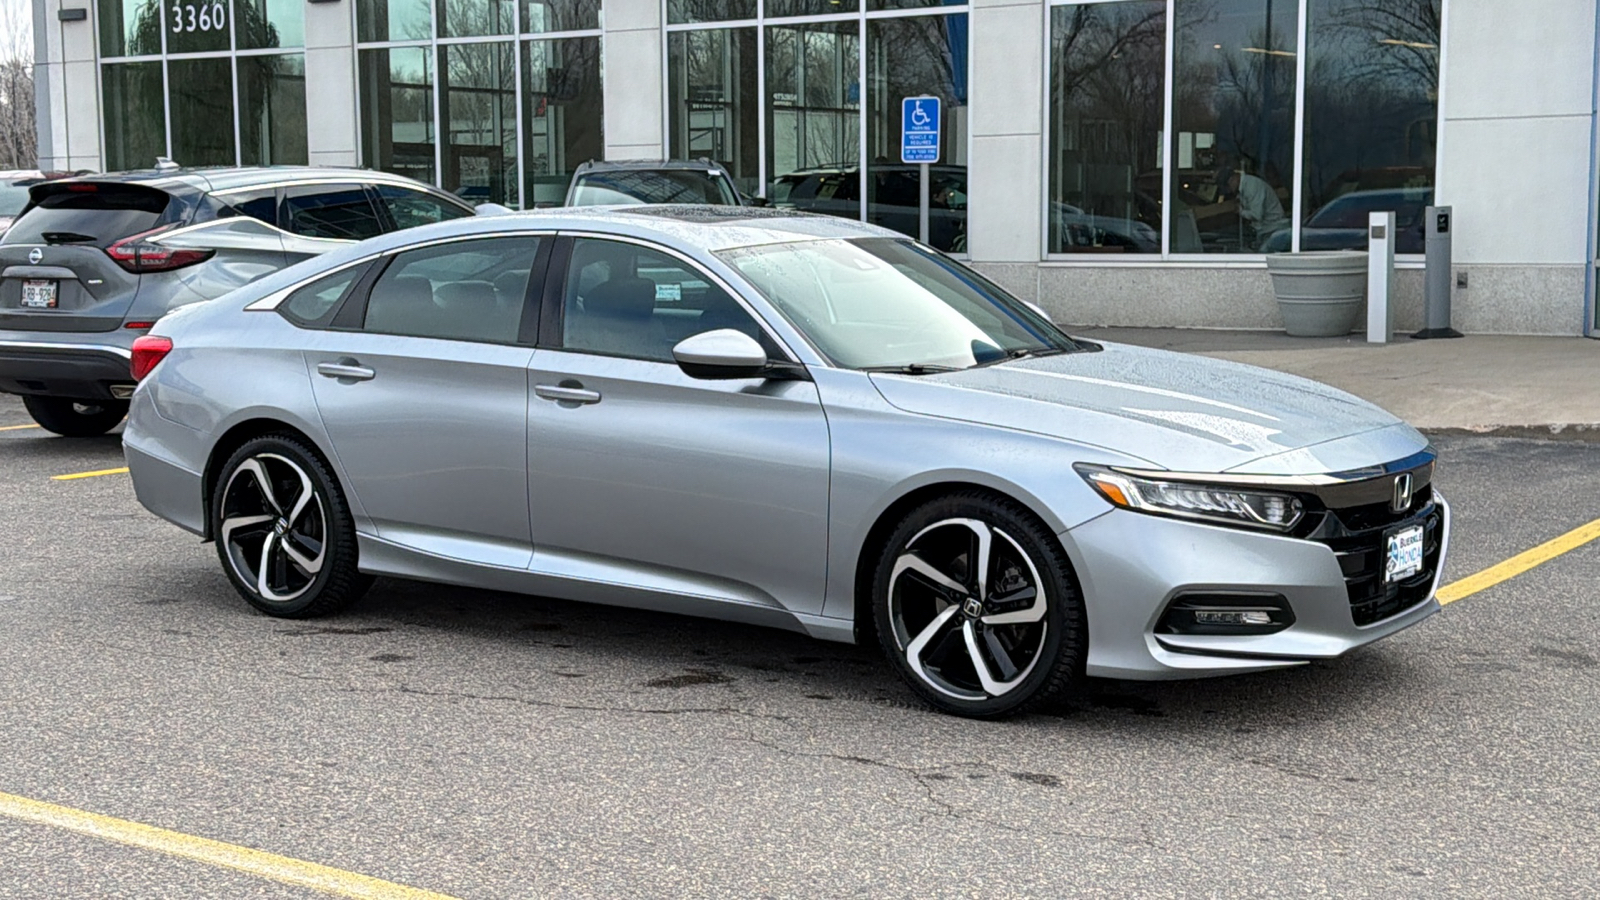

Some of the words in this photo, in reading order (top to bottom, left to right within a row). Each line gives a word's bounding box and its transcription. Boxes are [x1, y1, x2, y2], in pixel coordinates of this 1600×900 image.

[172, 3, 225, 33] 3360
[1400, 532, 1422, 548] BUERKLE
[1399, 546, 1422, 567] HONDA
